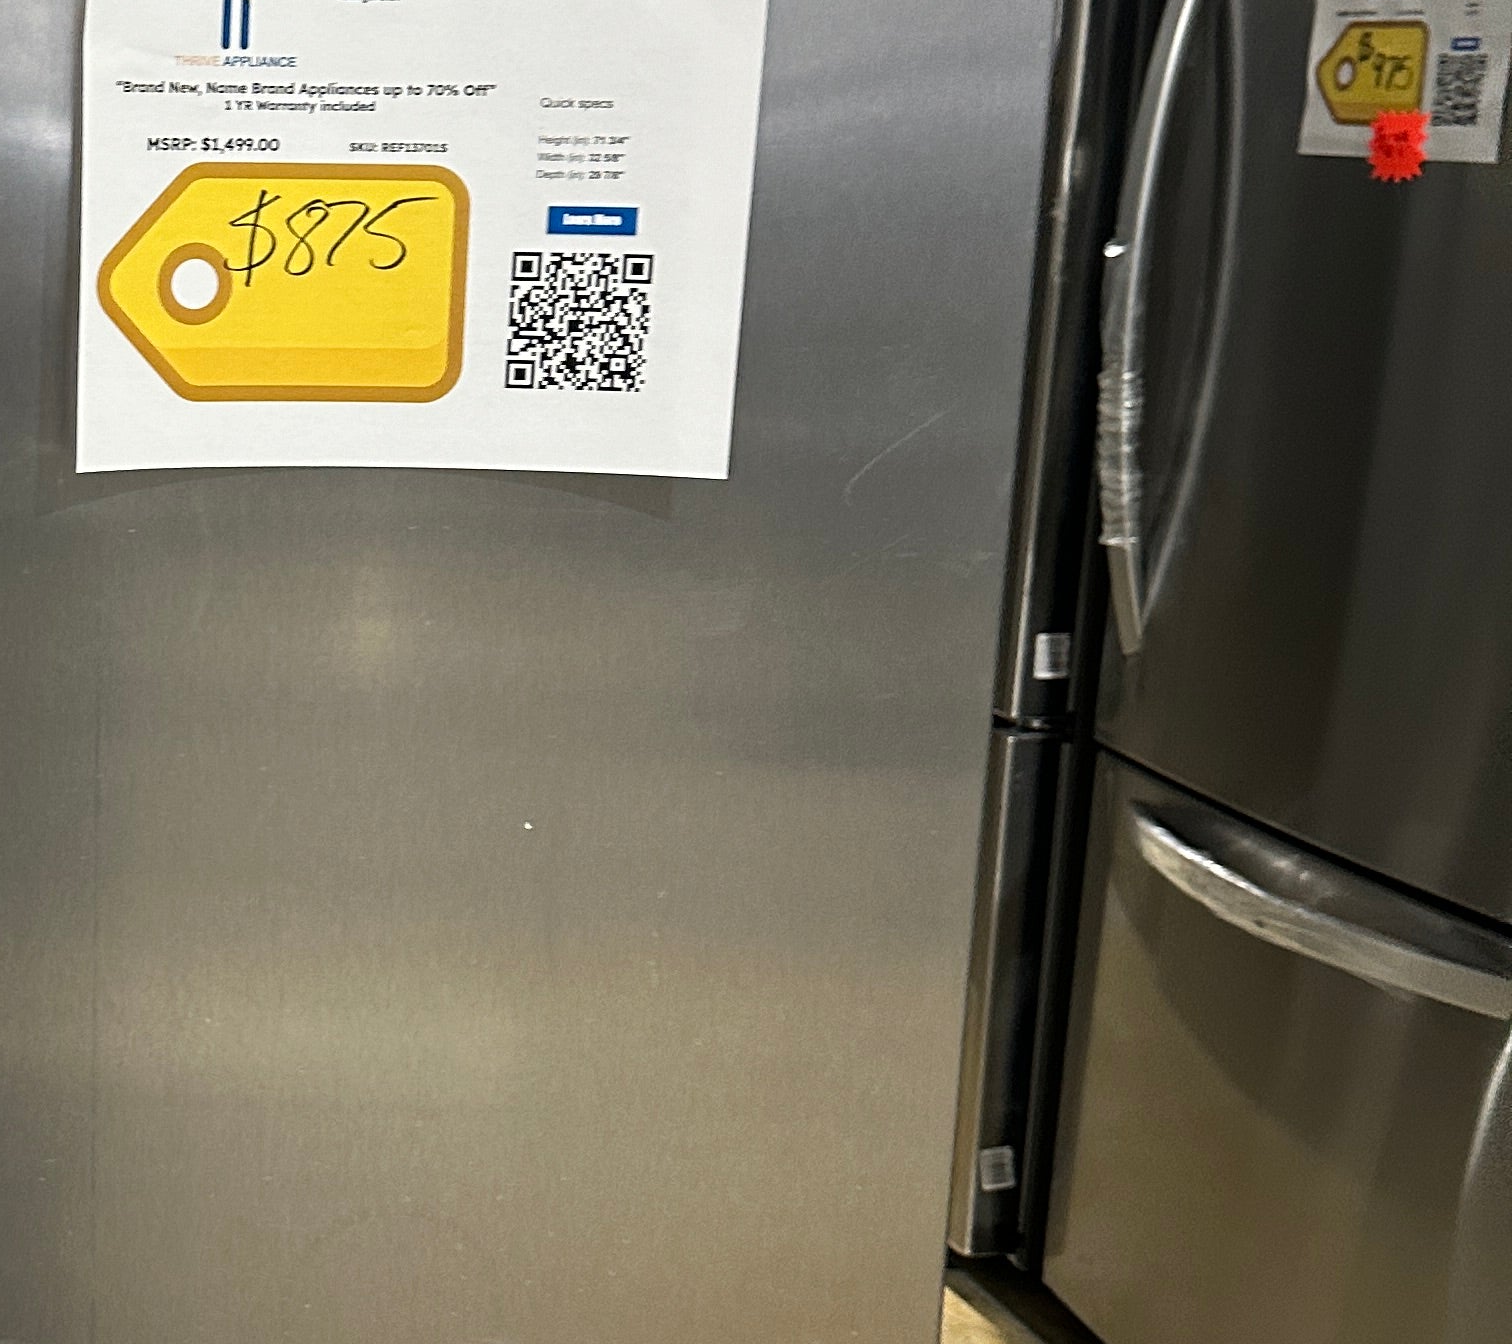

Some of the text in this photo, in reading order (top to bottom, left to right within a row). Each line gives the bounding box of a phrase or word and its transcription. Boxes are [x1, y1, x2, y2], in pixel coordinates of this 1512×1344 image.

[175, 56, 298, 68] THRIVE APPLIANCE
[169, 81, 203, 96] New,
[206, 82, 248, 95] Name
[252, 82, 296, 95] Brand
[299, 82, 380, 98] Appliances
[383, 85, 403, 99] up
[406, 83, 423, 97] to
[426, 84, 460, 97] 70%
[224, 100, 376, 114] 1 YR Warranty included
[540, 97, 614, 112] Quick specs
[147, 137, 281, 154] MSRP: $1,499.00
[349, 142, 379, 153] SKU:
[223, 189, 439, 287] $875
